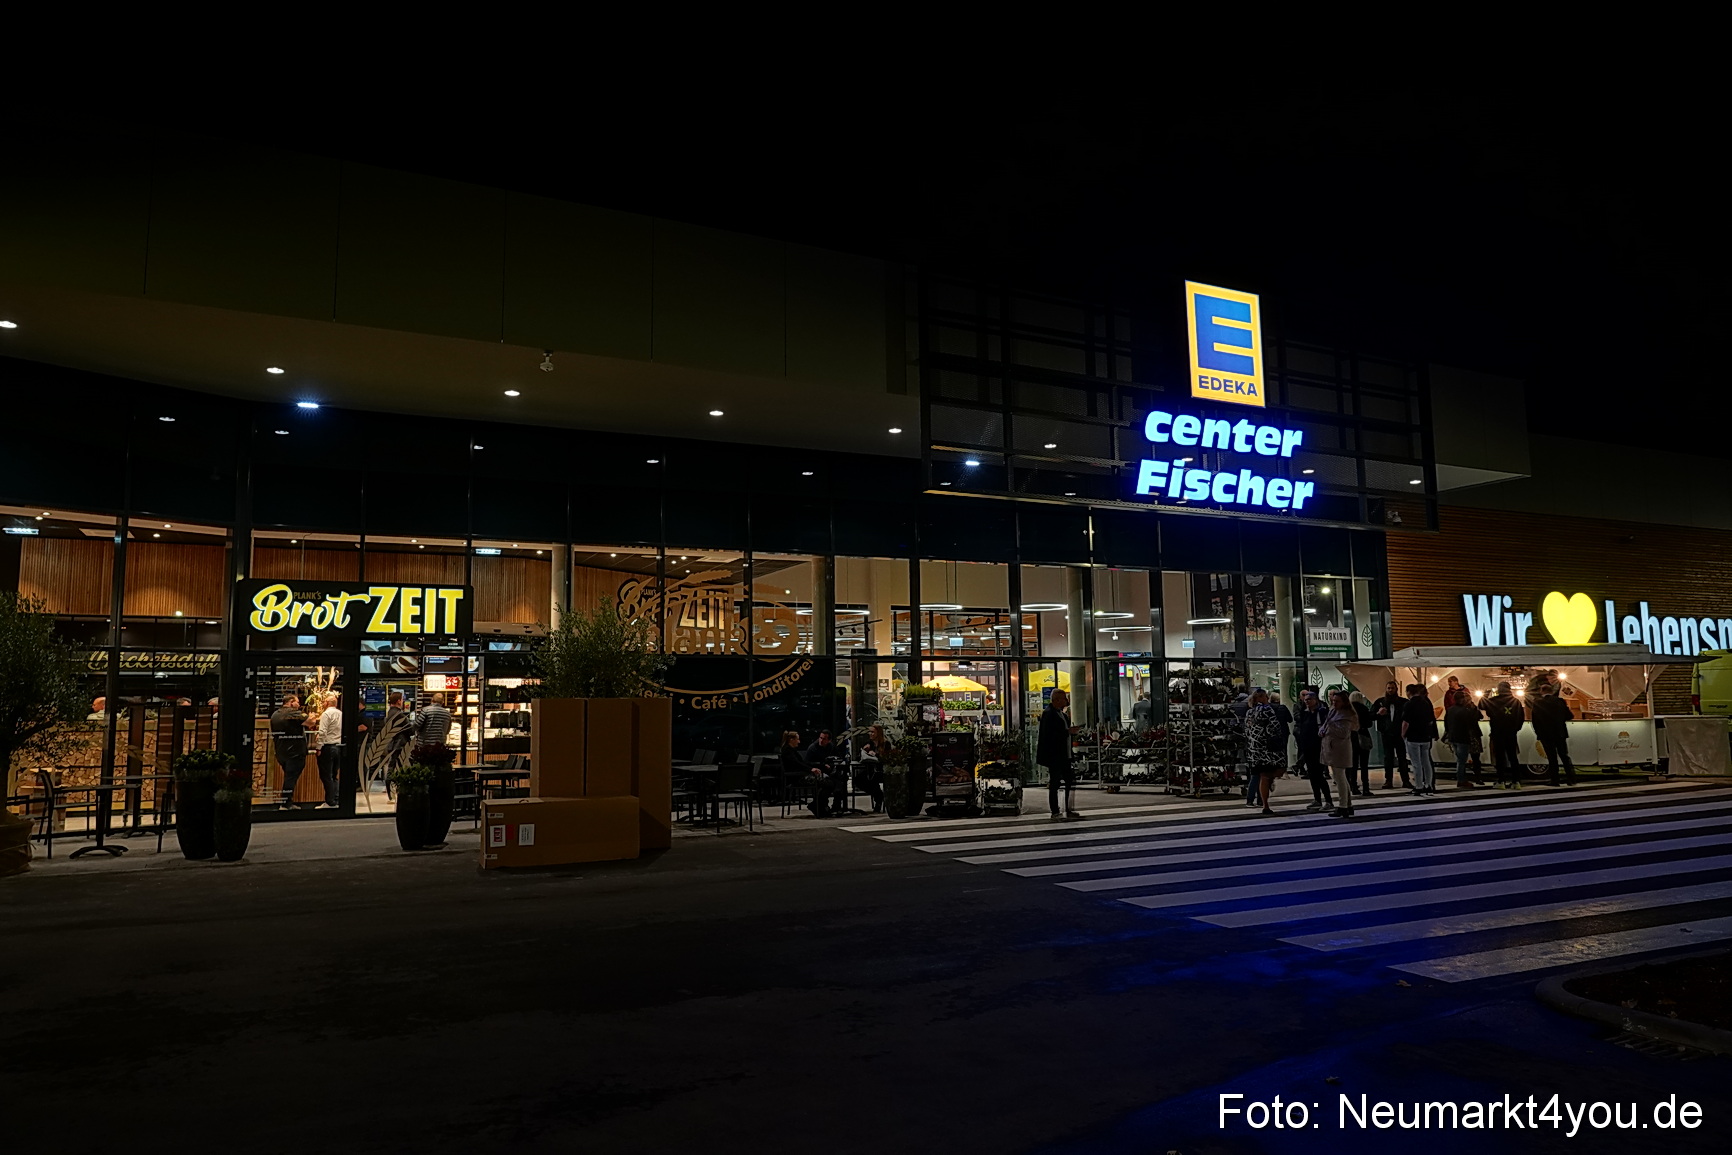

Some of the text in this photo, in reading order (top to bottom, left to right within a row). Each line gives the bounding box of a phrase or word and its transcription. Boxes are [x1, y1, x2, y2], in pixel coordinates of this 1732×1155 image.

[1198, 375, 1258, 397] EDEKA
[1144, 410, 1303, 457] center
[1136, 458, 1314, 509] Fischer
[250, 584, 464, 634] Brot ZEIT
[680, 587, 729, 630] ZEIT
[1463, 594, 1532, 646] Wir
[1313, 631, 1347, 641] NATURKIND
[691, 695, 727, 710] Café
